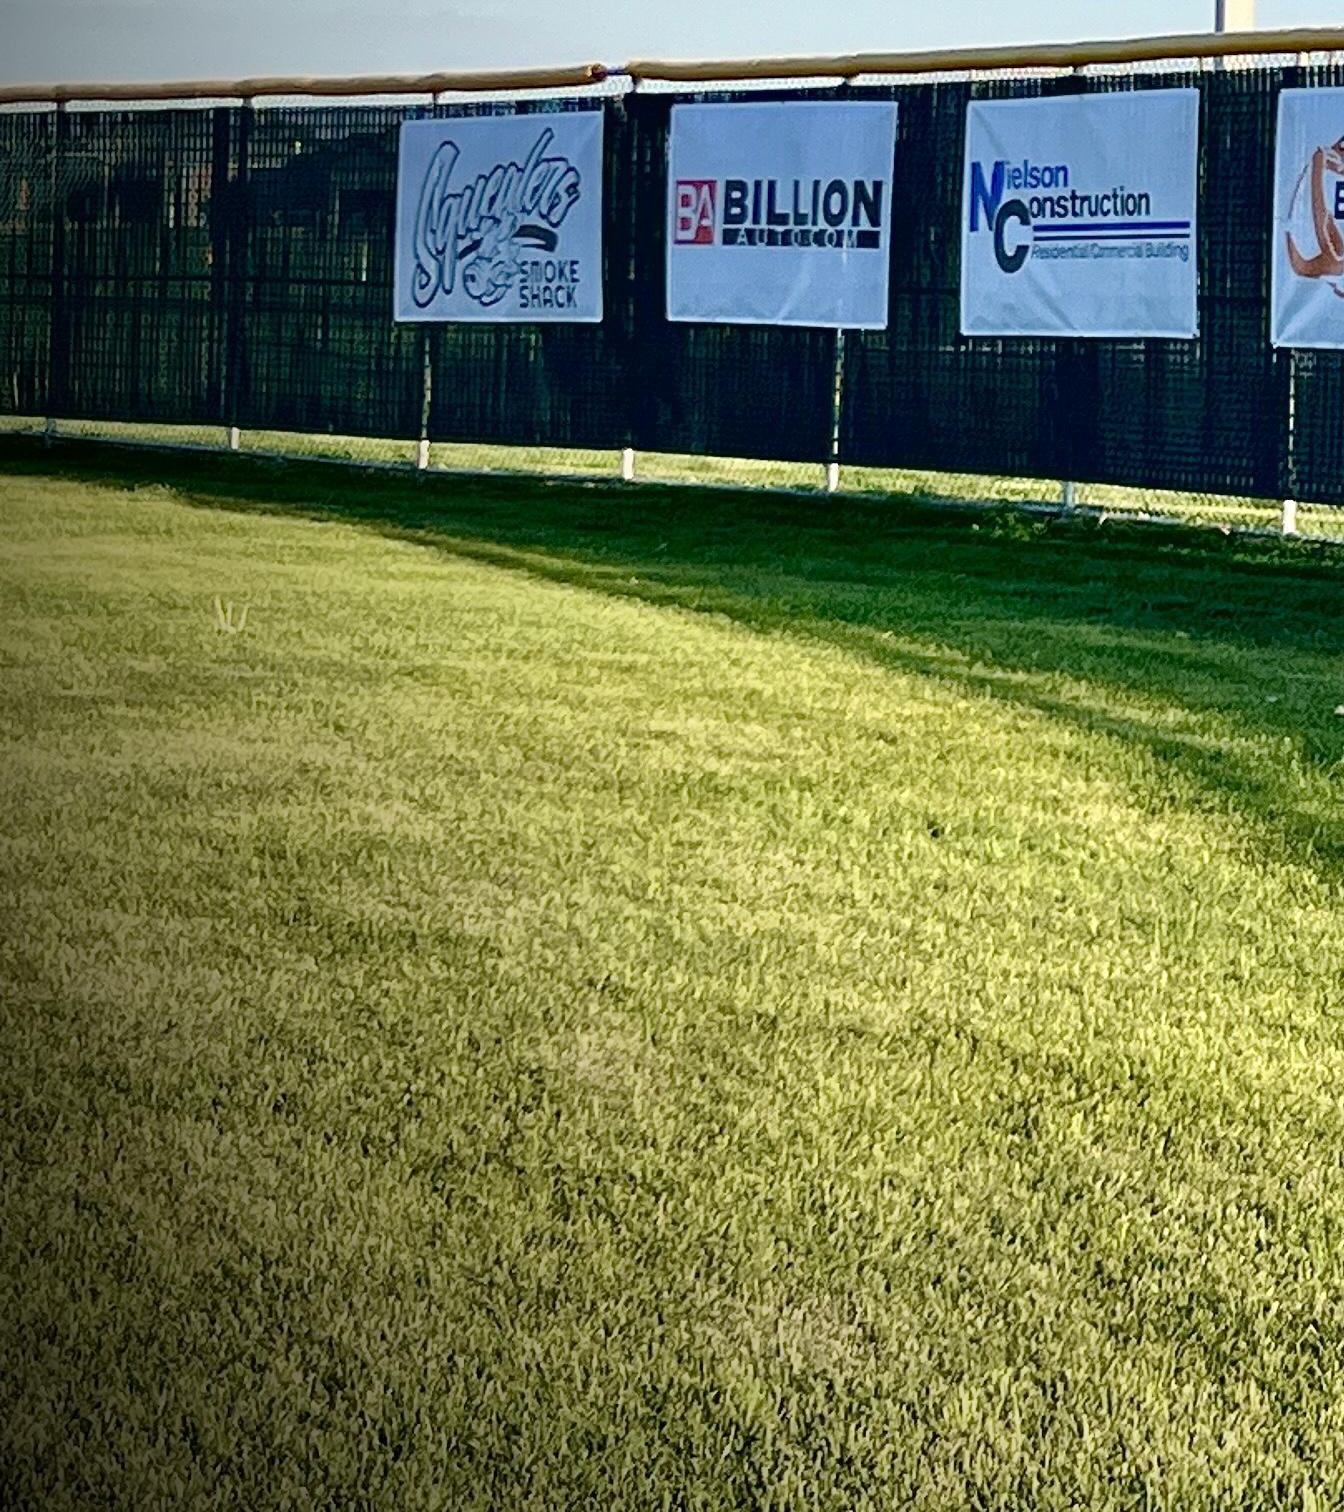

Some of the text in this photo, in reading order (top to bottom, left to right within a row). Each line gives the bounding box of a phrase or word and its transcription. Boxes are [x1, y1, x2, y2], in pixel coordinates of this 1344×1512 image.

[677, 183, 715, 241] BA
[723, 179, 883, 227] BILLION
[969, 159, 1069, 232] Nielson
[994, 186, 1151, 274] Construction
[518, 260, 581, 284] SMOKE
[519, 286, 578, 309] SHACK
